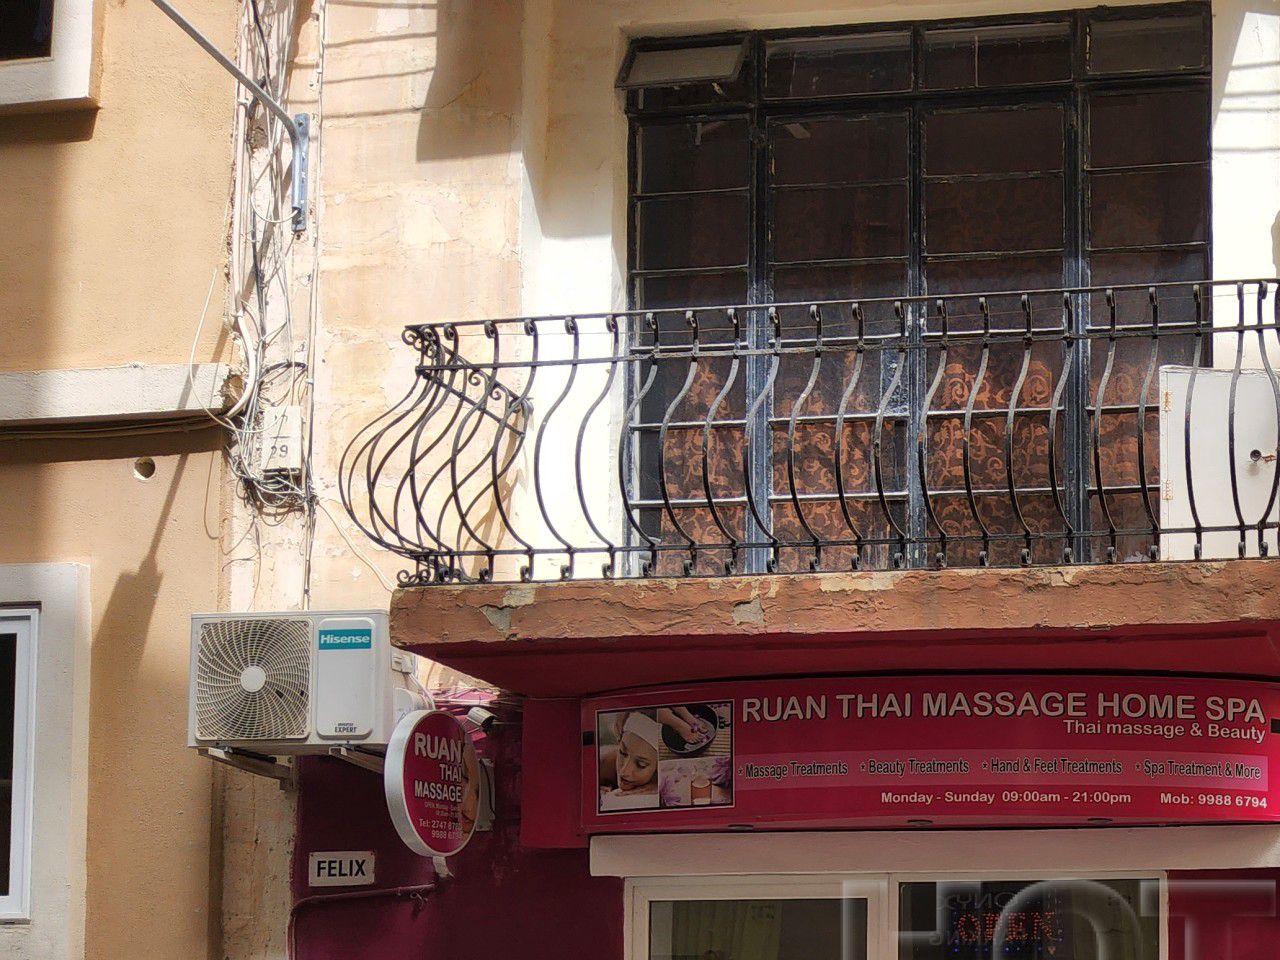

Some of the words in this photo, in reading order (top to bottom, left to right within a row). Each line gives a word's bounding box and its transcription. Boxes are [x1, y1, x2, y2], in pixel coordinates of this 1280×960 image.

[320, 634, 370, 644] Hisense
[742, 695, 826, 722] RUAN
[836, 692, 911, 719] THAI
[922, 691, 1087, 718] MASSAGE
[1097, 692, 1196, 720] HOME
[1205, 696, 1267, 724] SPA
[1063, 719, 1101, 734] Thai
[1106, 721, 1185, 739] massage
[1190, 722, 1203, 737] &
[1208, 723, 1266, 743] Beauty
[414, 732, 463, 763] RUAN
[439, 763, 463, 783] THAI
[745, 762, 788, 780] Massage
[790, 760, 849, 777] Treatments
[869, 758, 905, 777] Beauty
[908, 758, 969, 774] Treatments
[991, 757, 1020, 773] Hand
[1023, 758, 1032, 772] &
[1034, 758, 1058, 772] Feet
[1060, 757, 1122, 774] Treatments
[1144, 759, 1165, 779] Spa
[1167, 760, 1223, 777] Treatment
[1225, 762, 1233, 777] &
[1235, 763, 1262, 779] More
[414, 779, 462, 803] MASSAGE
[881, 791, 934, 805] Monday
[944, 791, 995, 805] Sunday
[1002, 790, 1061, 803] 09:00am
[1072, 791, 1131, 805] 21:00pm
[1160, 792, 1195, 805] Mob:
[1198, 793, 1232, 807] 9988
[1235, 795, 1268, 809] 6794
[316, 860, 367, 878] FELIX
[958, 912, 1056, 942] OPEN
